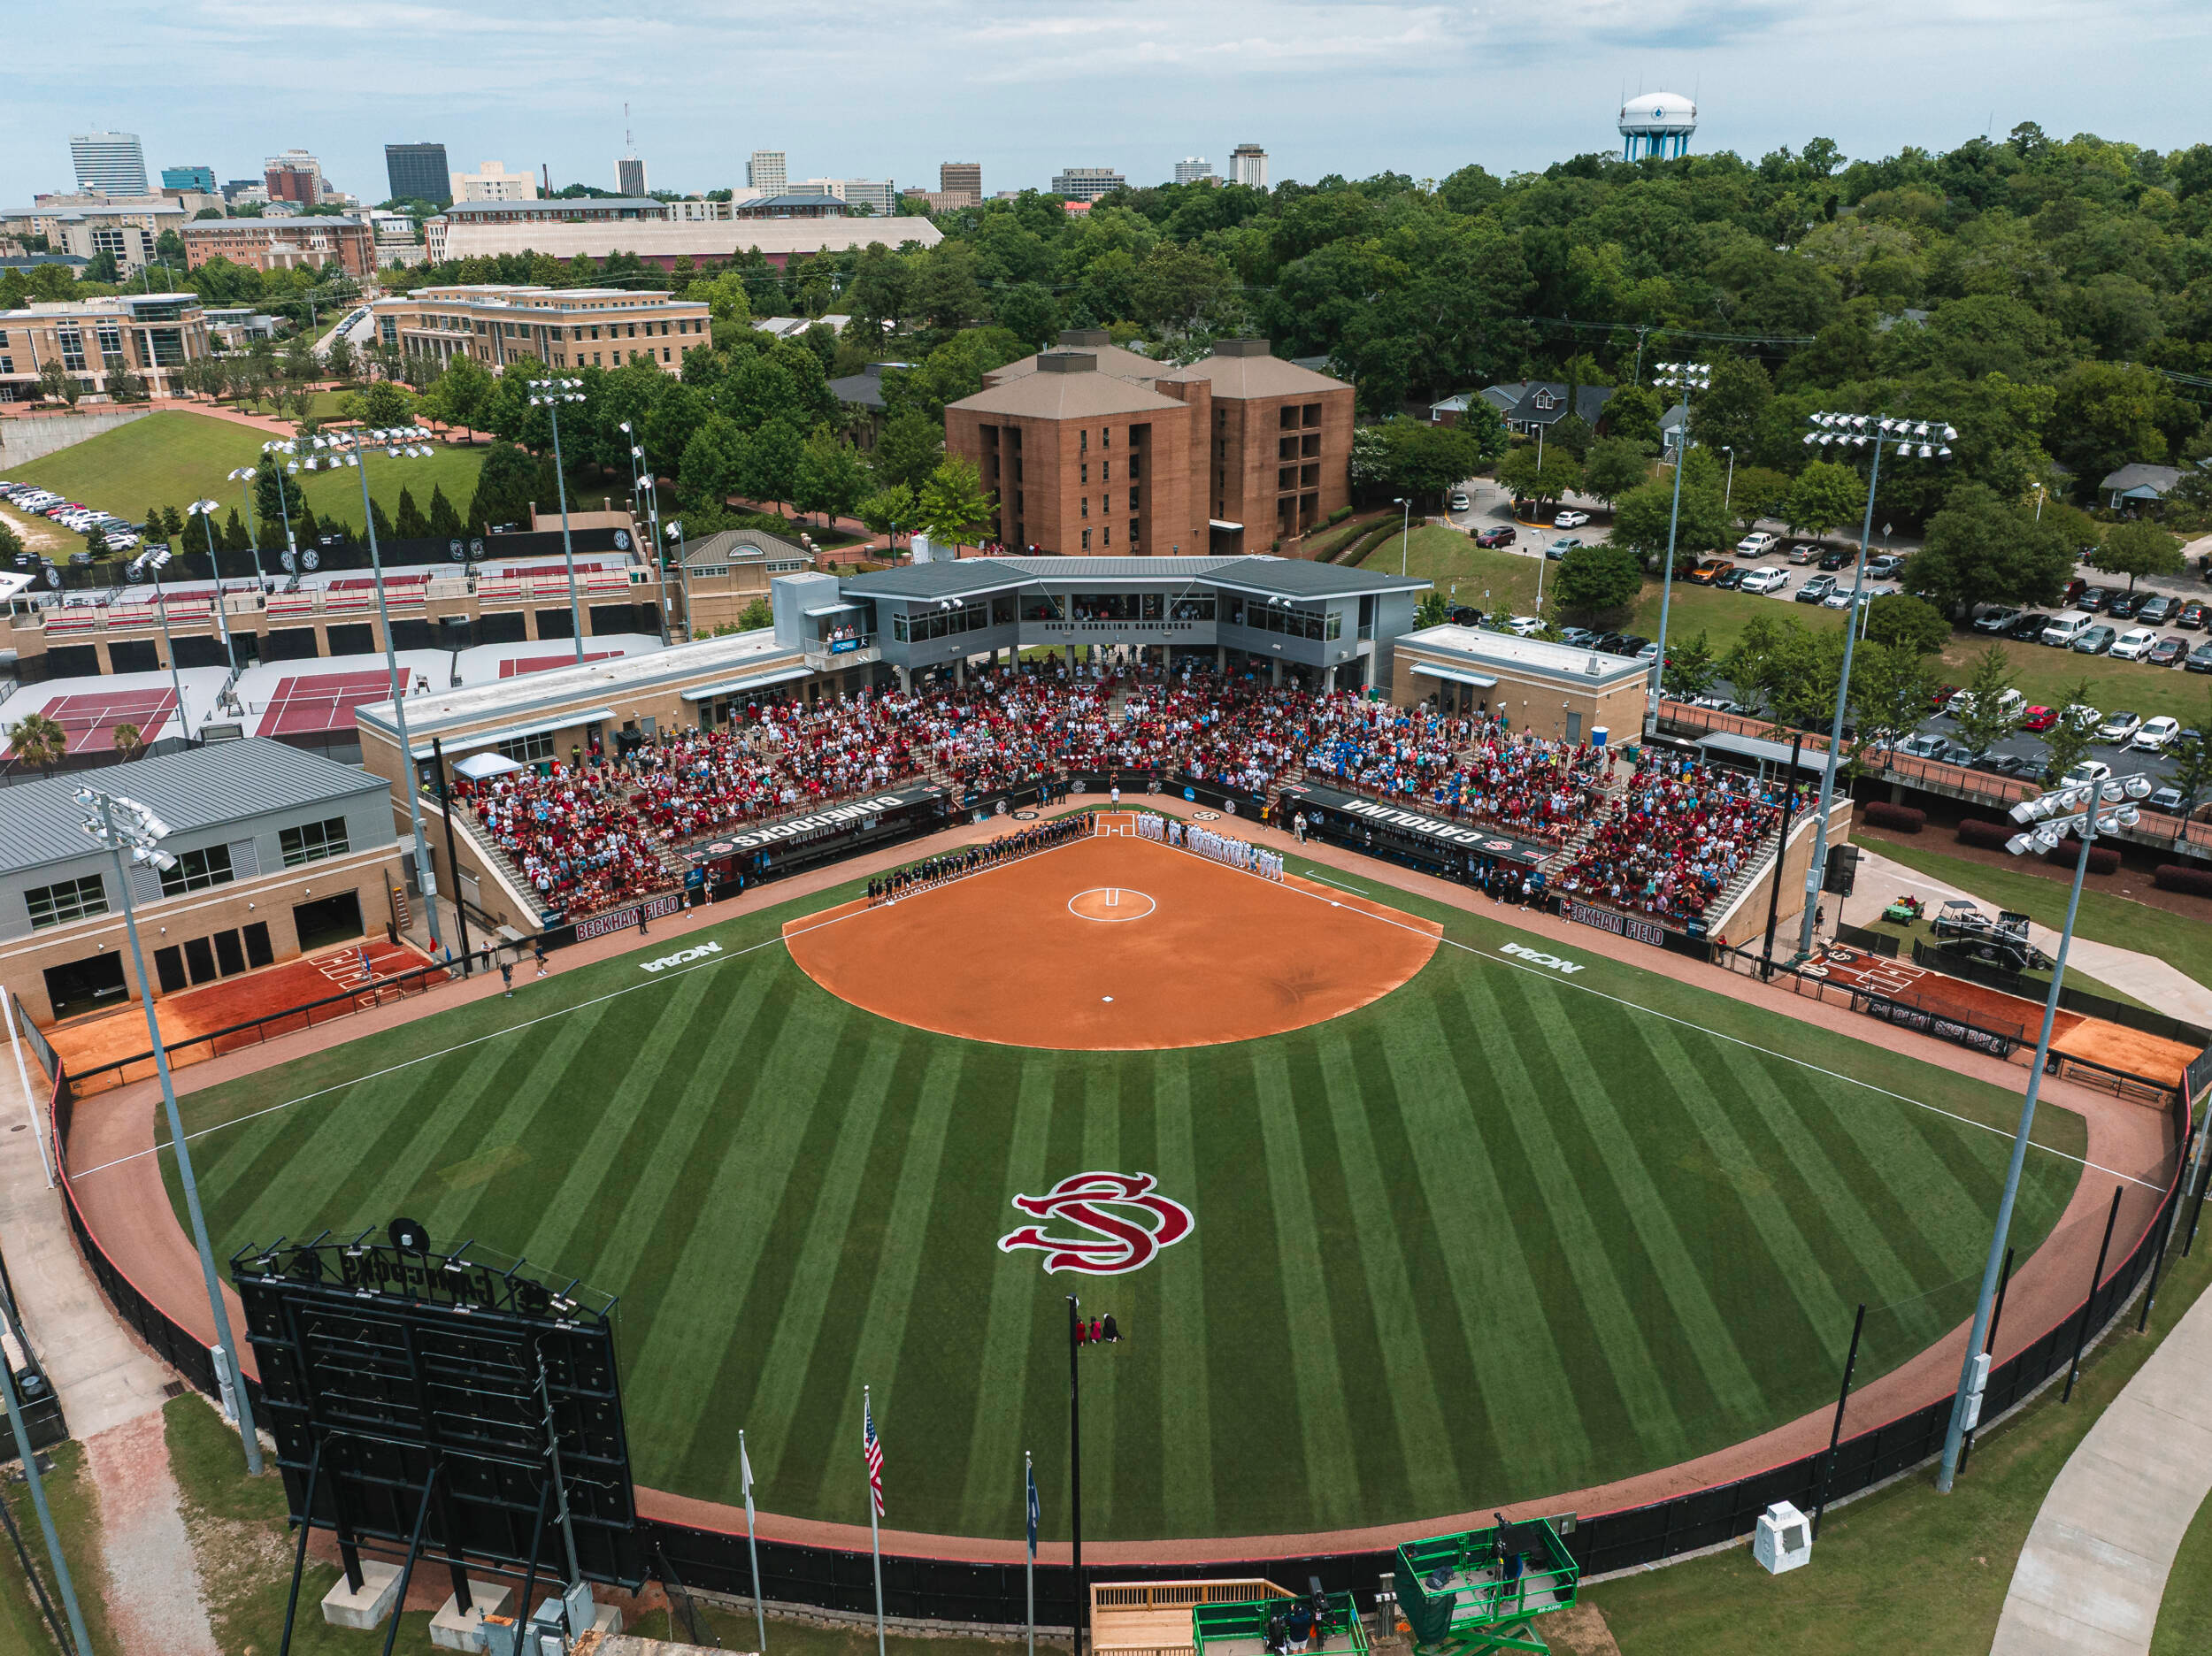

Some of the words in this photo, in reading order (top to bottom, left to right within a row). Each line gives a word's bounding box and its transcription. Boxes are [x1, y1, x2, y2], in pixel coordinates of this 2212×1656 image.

[303, 549, 319, 569] SEC
[731, 796, 904, 847] GAMECOCKS
[788, 826, 836, 846] CAROLINA
[1340, 799, 1484, 844] CAROLINA
[576, 906, 641, 941] BECKHAM
[644, 896, 679, 921] FIELD
[1625, 919, 1664, 946] FIELD
[638, 940, 724, 973] NCAA
[1499, 942, 1586, 974] NCAA
[1933, 1019, 2000, 1054] SOFTBALL
